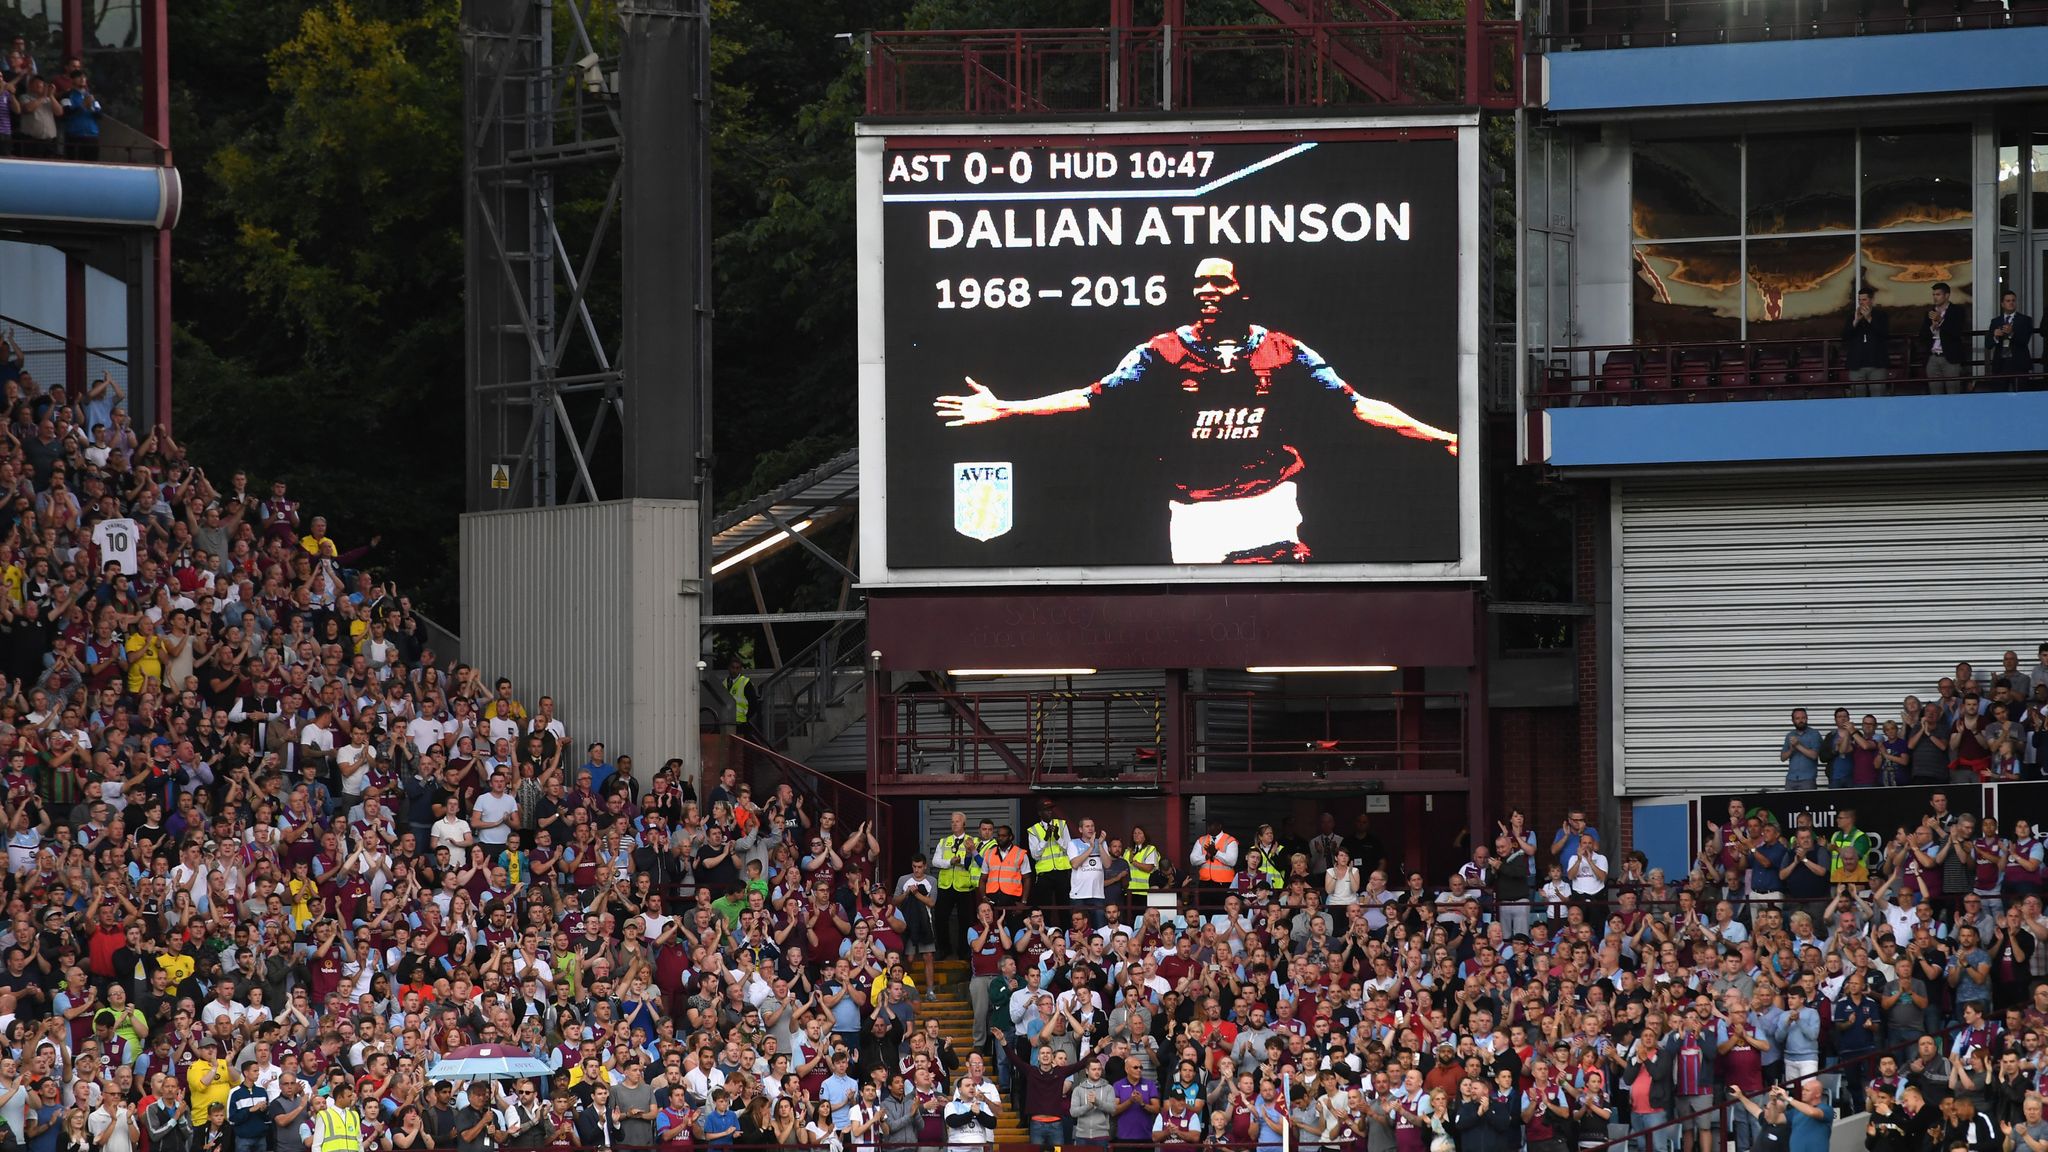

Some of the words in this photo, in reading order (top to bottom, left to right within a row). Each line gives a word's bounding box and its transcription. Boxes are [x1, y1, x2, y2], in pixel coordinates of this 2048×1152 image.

[888, 154, 951, 183] AST
[1049, 151, 1118, 180] HUD
[1129, 151, 1215, 179] 10:47
[929, 206, 1123, 249] DALIAN
[1136, 202, 1410, 246] ATKINSON
[1195, 407, 1266, 427] mita
[960, 467, 1009, 482] AVFC
[106, 532, 127, 551] 10
[1788, 804, 1837, 829] inuit
